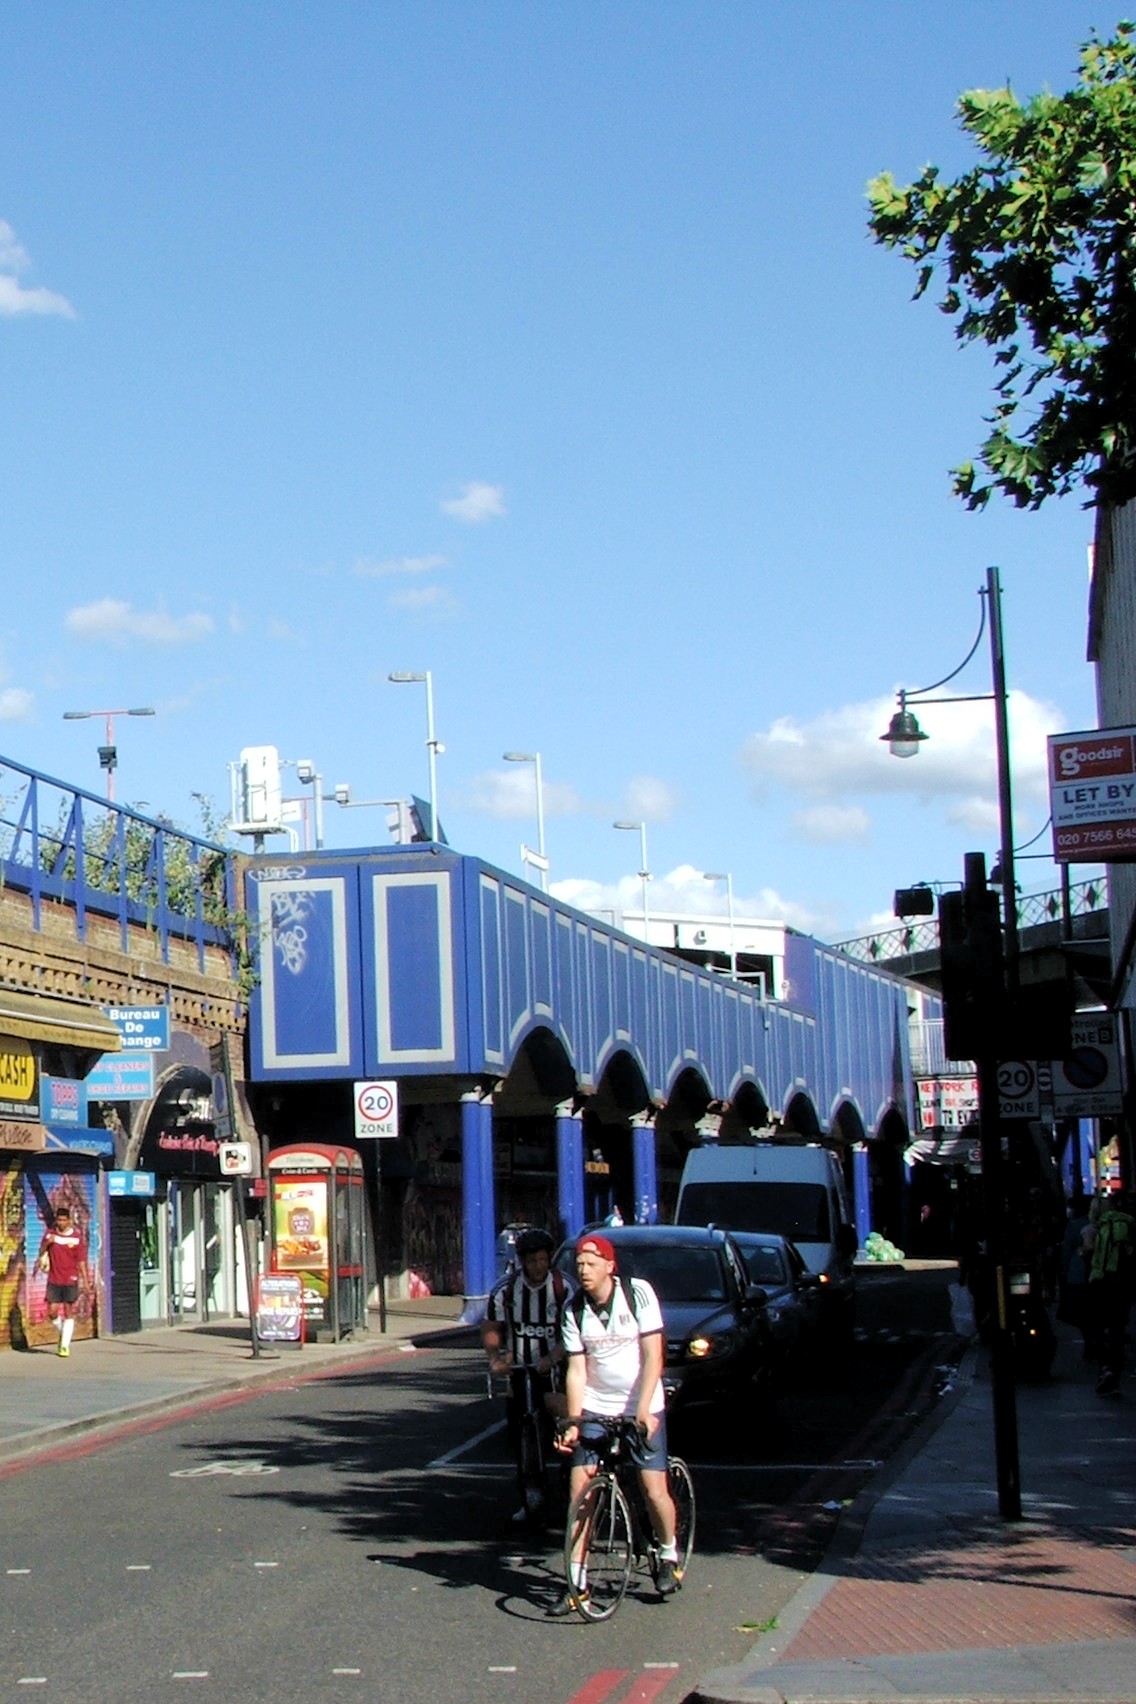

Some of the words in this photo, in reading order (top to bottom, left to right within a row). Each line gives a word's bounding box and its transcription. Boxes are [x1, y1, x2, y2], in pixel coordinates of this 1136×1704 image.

[1059, 746, 1124, 776] goodsir
[1063, 786, 1100, 804] LET
[1107, 783, 1135, 799] BY
[1057, 832, 1080, 847] 020
[109, 1009, 160, 1020] Bureau
[125, 1021, 144, 1033] De
[999, 1070, 1028, 1087] 20
[364, 1096, 388, 1111] 20
[359, 1123, 393, 1135] ZONE
[515, 1323, 555, 1339] Jeep
